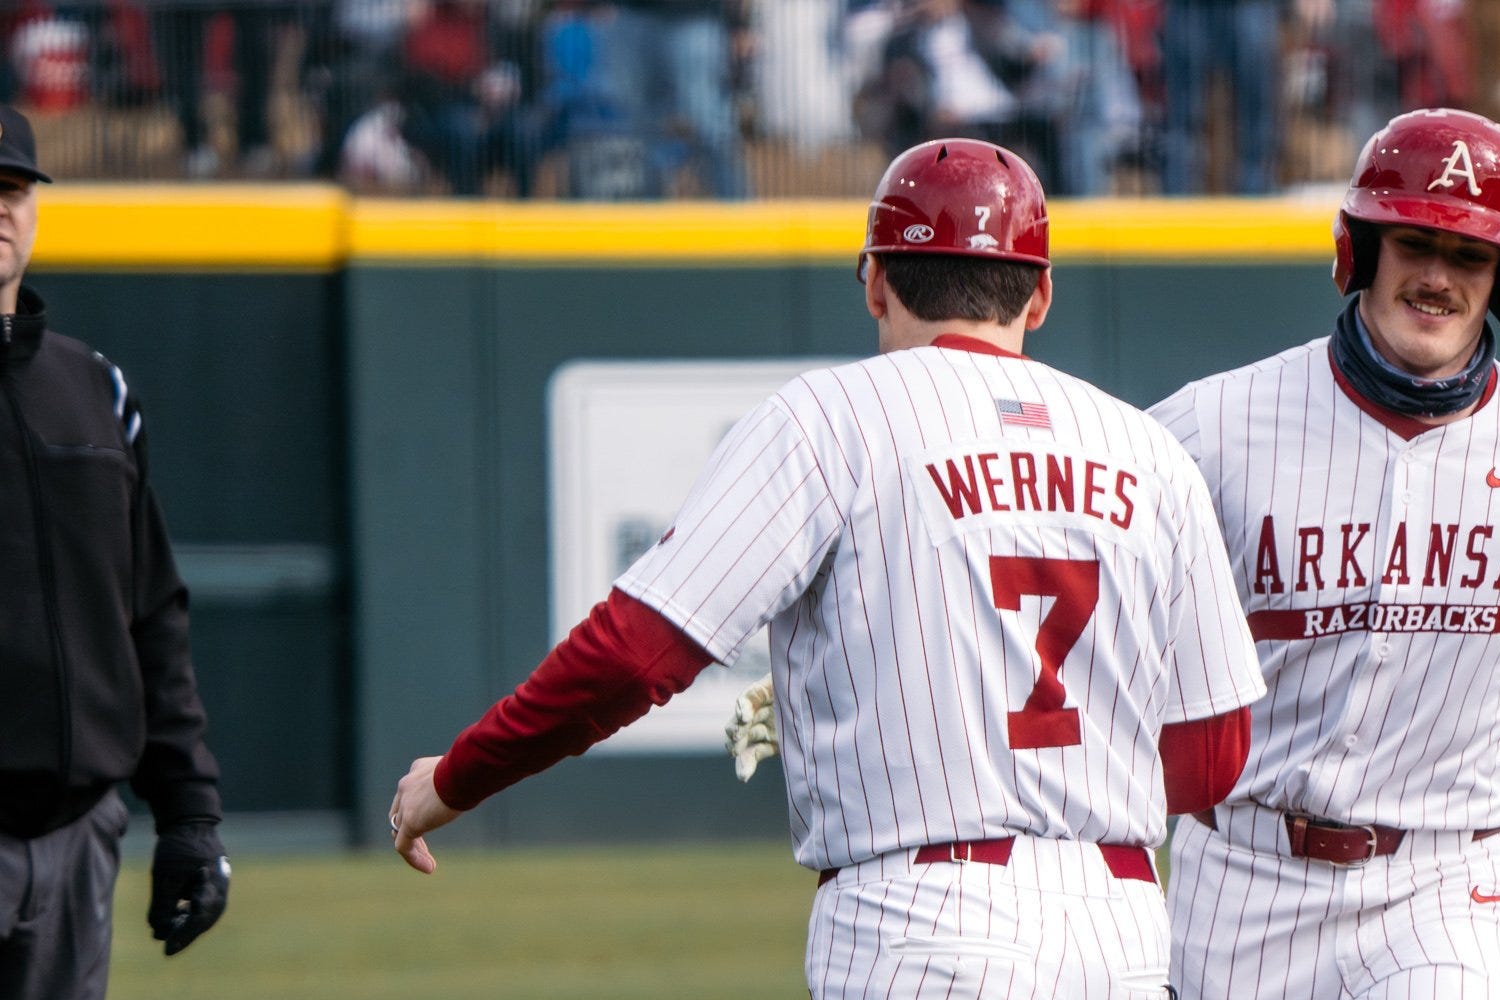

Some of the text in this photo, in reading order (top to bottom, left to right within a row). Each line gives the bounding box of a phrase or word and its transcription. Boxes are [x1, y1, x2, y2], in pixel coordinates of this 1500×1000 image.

[1427, 140, 1482, 196] A
[974, 206, 991, 231] 7
[925, 451, 1138, 531] WERNES
[1303, 602, 1499, 637] RAZORBACKS
[988, 555, 1100, 750] 7
